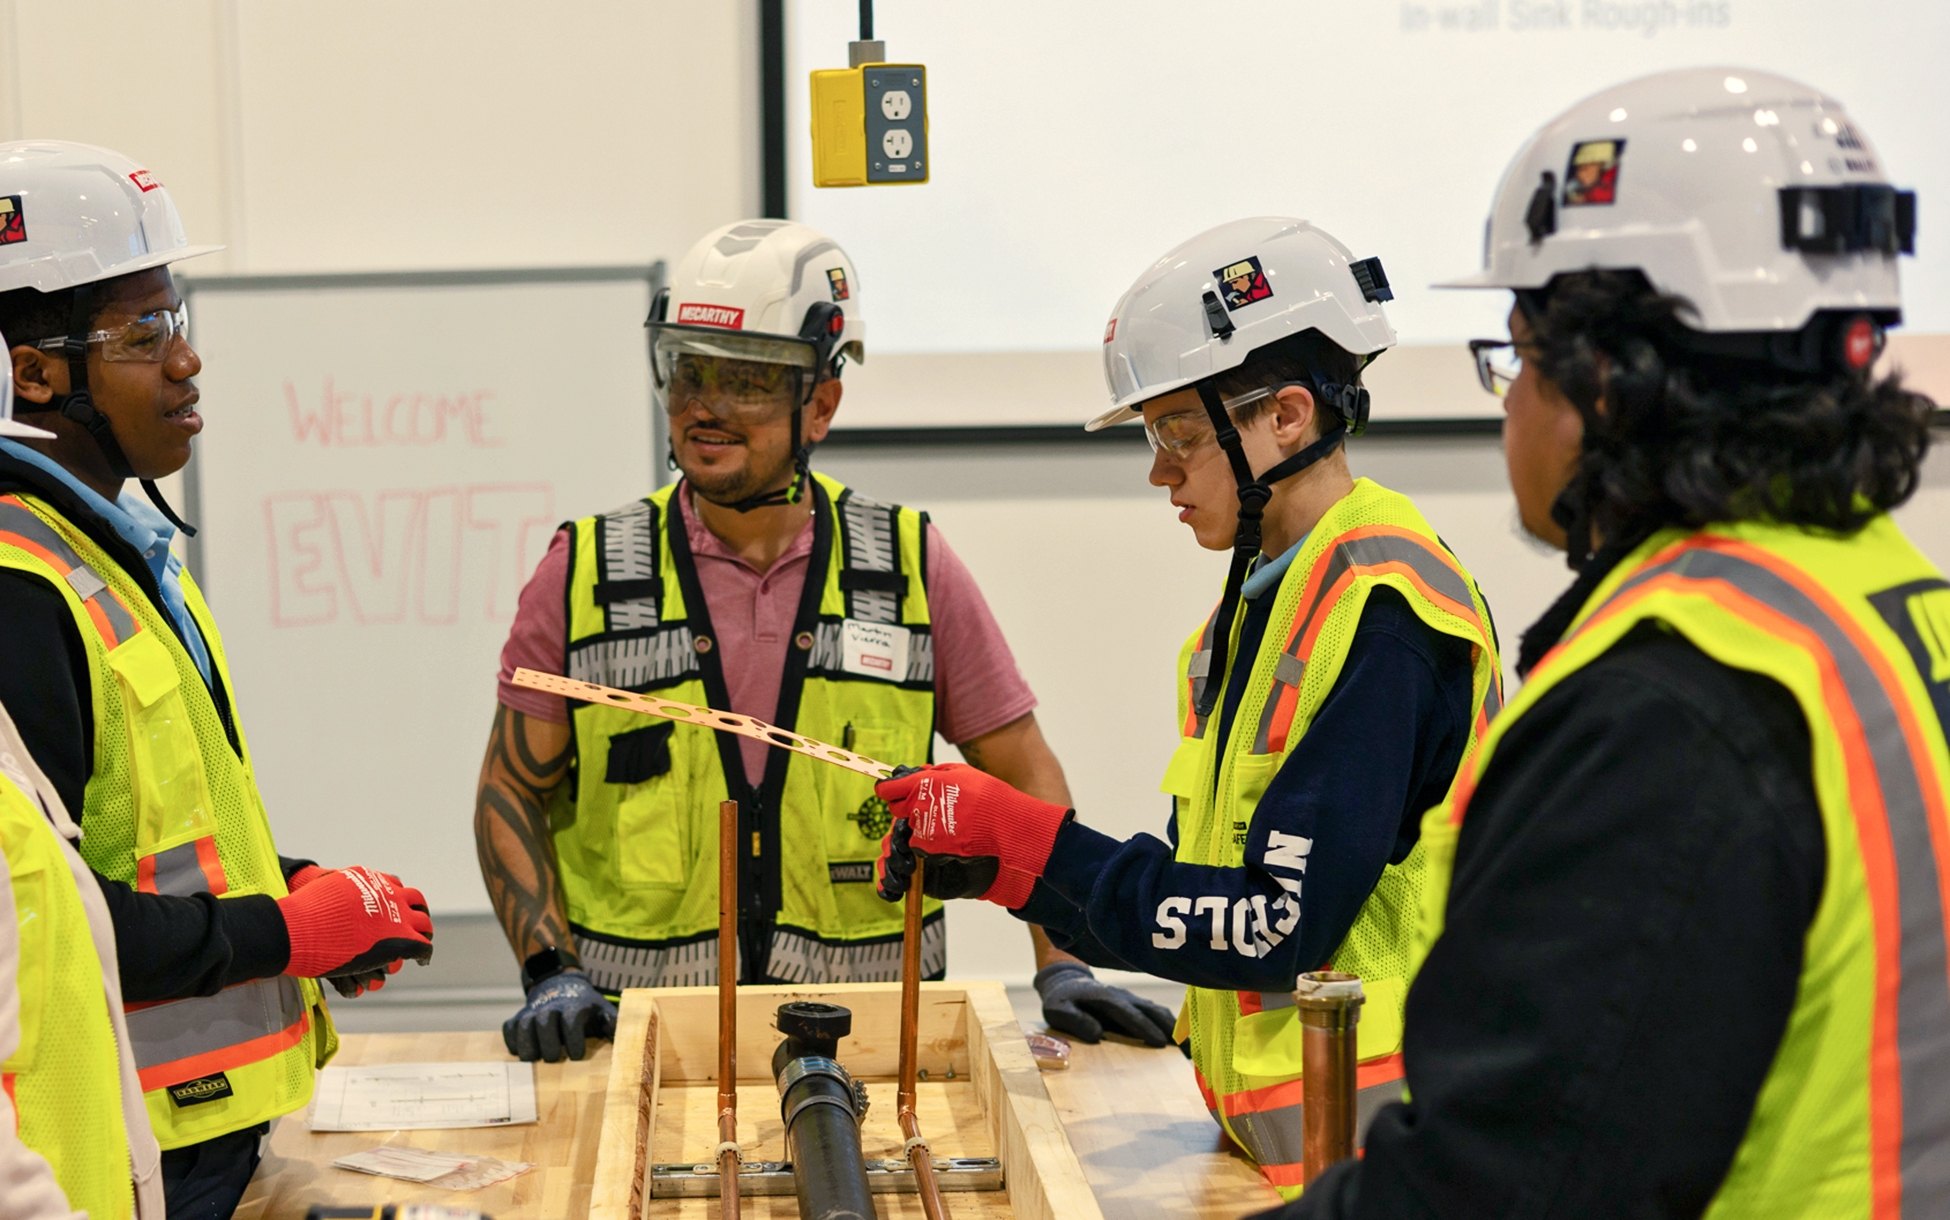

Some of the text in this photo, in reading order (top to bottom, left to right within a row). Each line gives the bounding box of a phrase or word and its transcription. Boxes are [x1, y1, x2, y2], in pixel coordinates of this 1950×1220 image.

[283, 374, 506, 448] WELCOME
[262, 480, 554, 627] EVIT
[945, 783, 960, 835] Milwaukee
